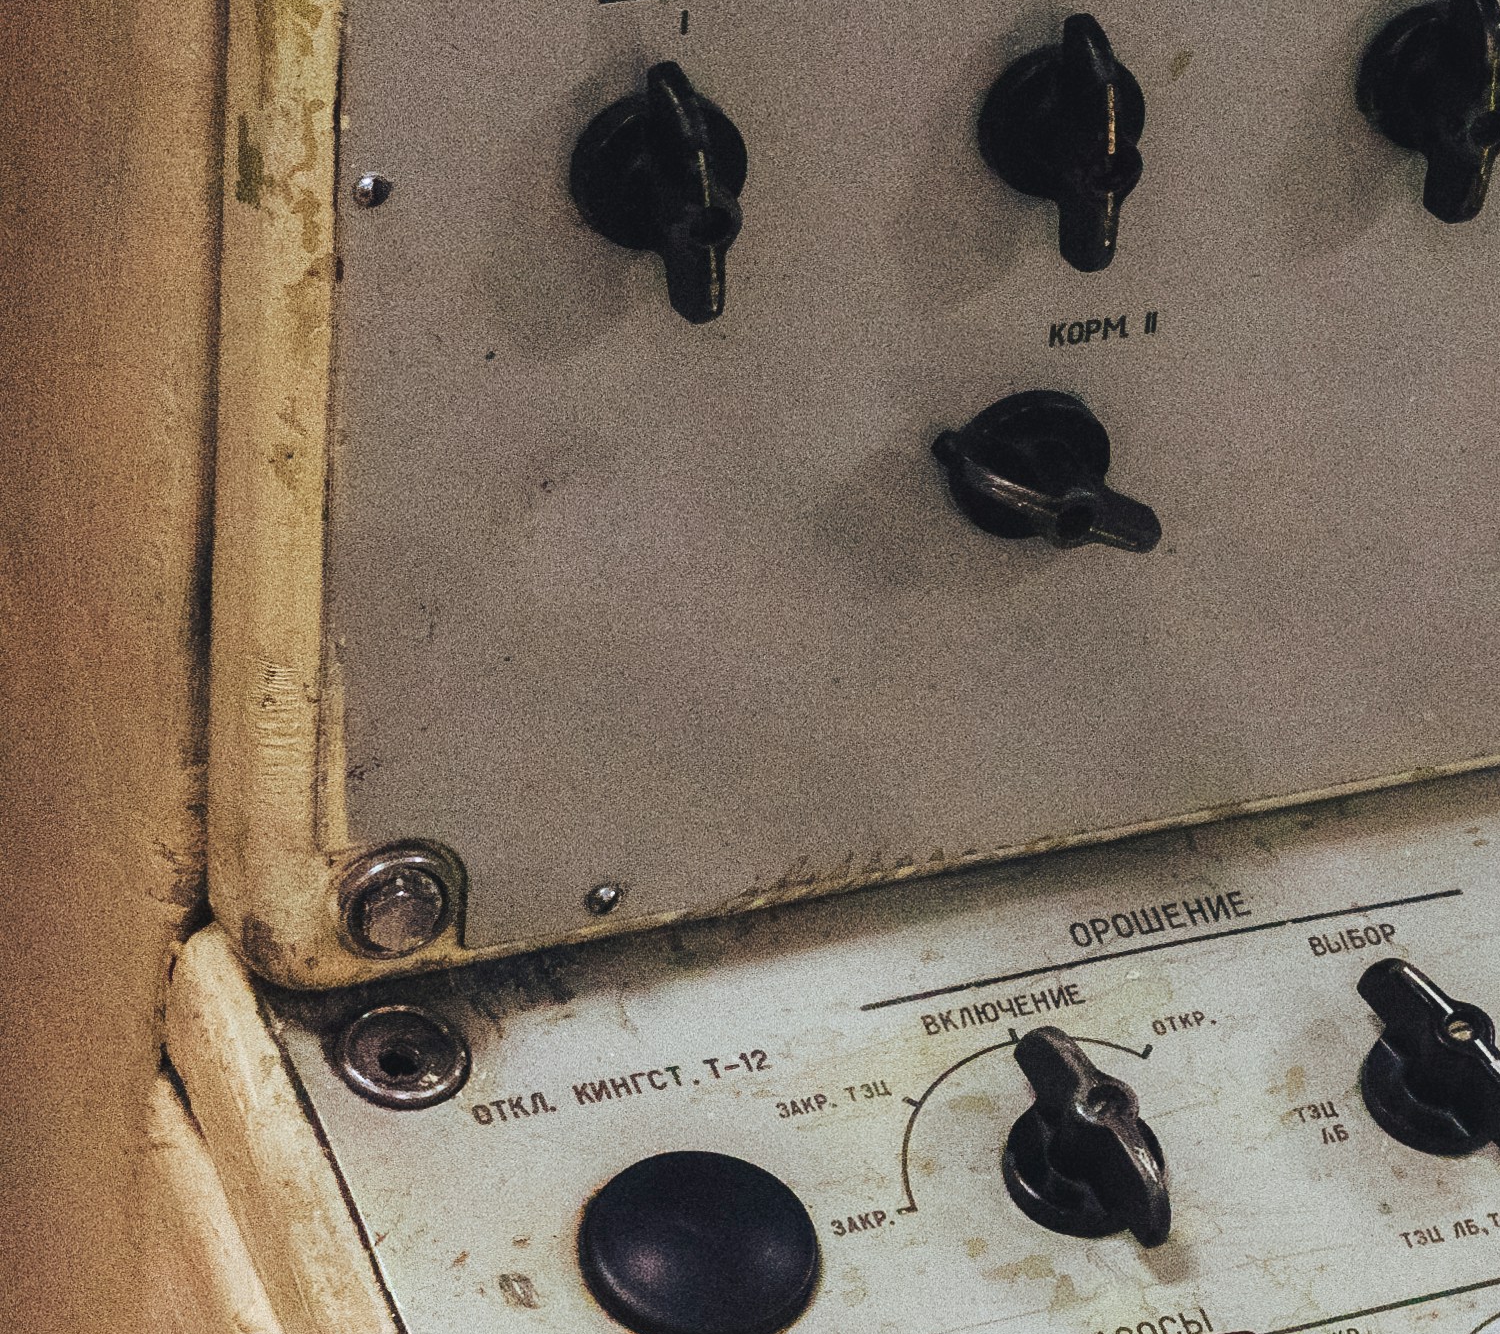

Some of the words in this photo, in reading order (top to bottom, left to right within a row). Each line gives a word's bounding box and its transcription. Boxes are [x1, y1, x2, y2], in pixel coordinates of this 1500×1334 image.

[1068, 889, 1253, 951] ОРОШЕНИЕ
[1308, 924, 1397, 957] ВЫБОР
[921, 983, 1086, 1037] ВКЛЮЧЕНИЕ
[1152, 1011, 1219, 1038] ОТКР.
[472, 1091, 556, 1126] ОТКЛ.
[572, 1065, 700, 1107] КИНГСТ.
[703, 1049, 771, 1083] Т-12
[776, 1093, 837, 1120] ЗАКР.
[830, 1209, 898, 1238] ЗАКР.
